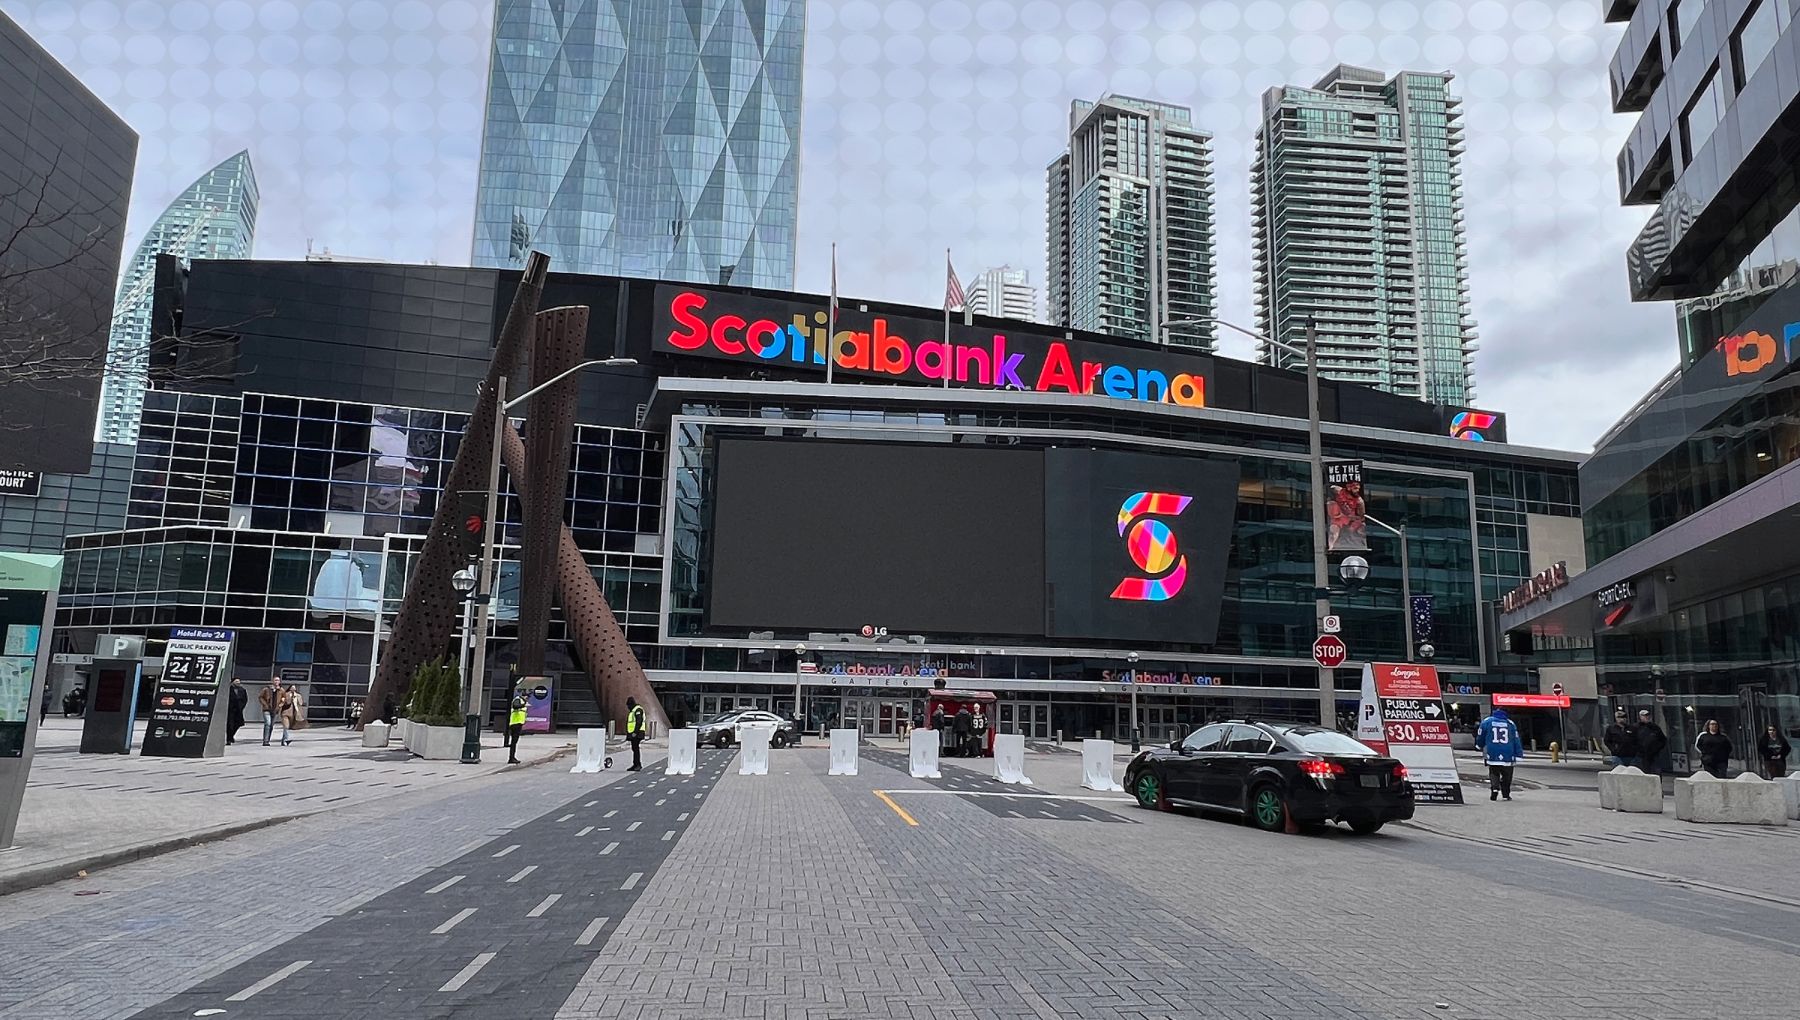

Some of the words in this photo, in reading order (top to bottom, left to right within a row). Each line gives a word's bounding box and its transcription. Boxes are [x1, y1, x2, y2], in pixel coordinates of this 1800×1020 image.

[667, 292, 1030, 391] Scotiabank
[1036, 343, 1205, 408] Arena
[1328, 465, 1340, 474] WE
[1342, 465, 1360, 474] THE
[1328, 473, 1361, 482] NORTH
[874, 627, 888, 636] LG
[112, 638, 129, 656] P
[194, 644, 226, 652] PARKING
[1315, 645, 1344, 658] STOP
[1181, 673, 1221, 686] Arena
[1446, 683, 1481, 694] Arena
[1386, 699, 1419, 709] PUBLIC
[1384, 709, 1425, 719] PARKING
[972, 718, 984, 729] 93
[1492, 727, 1509, 744] 13
